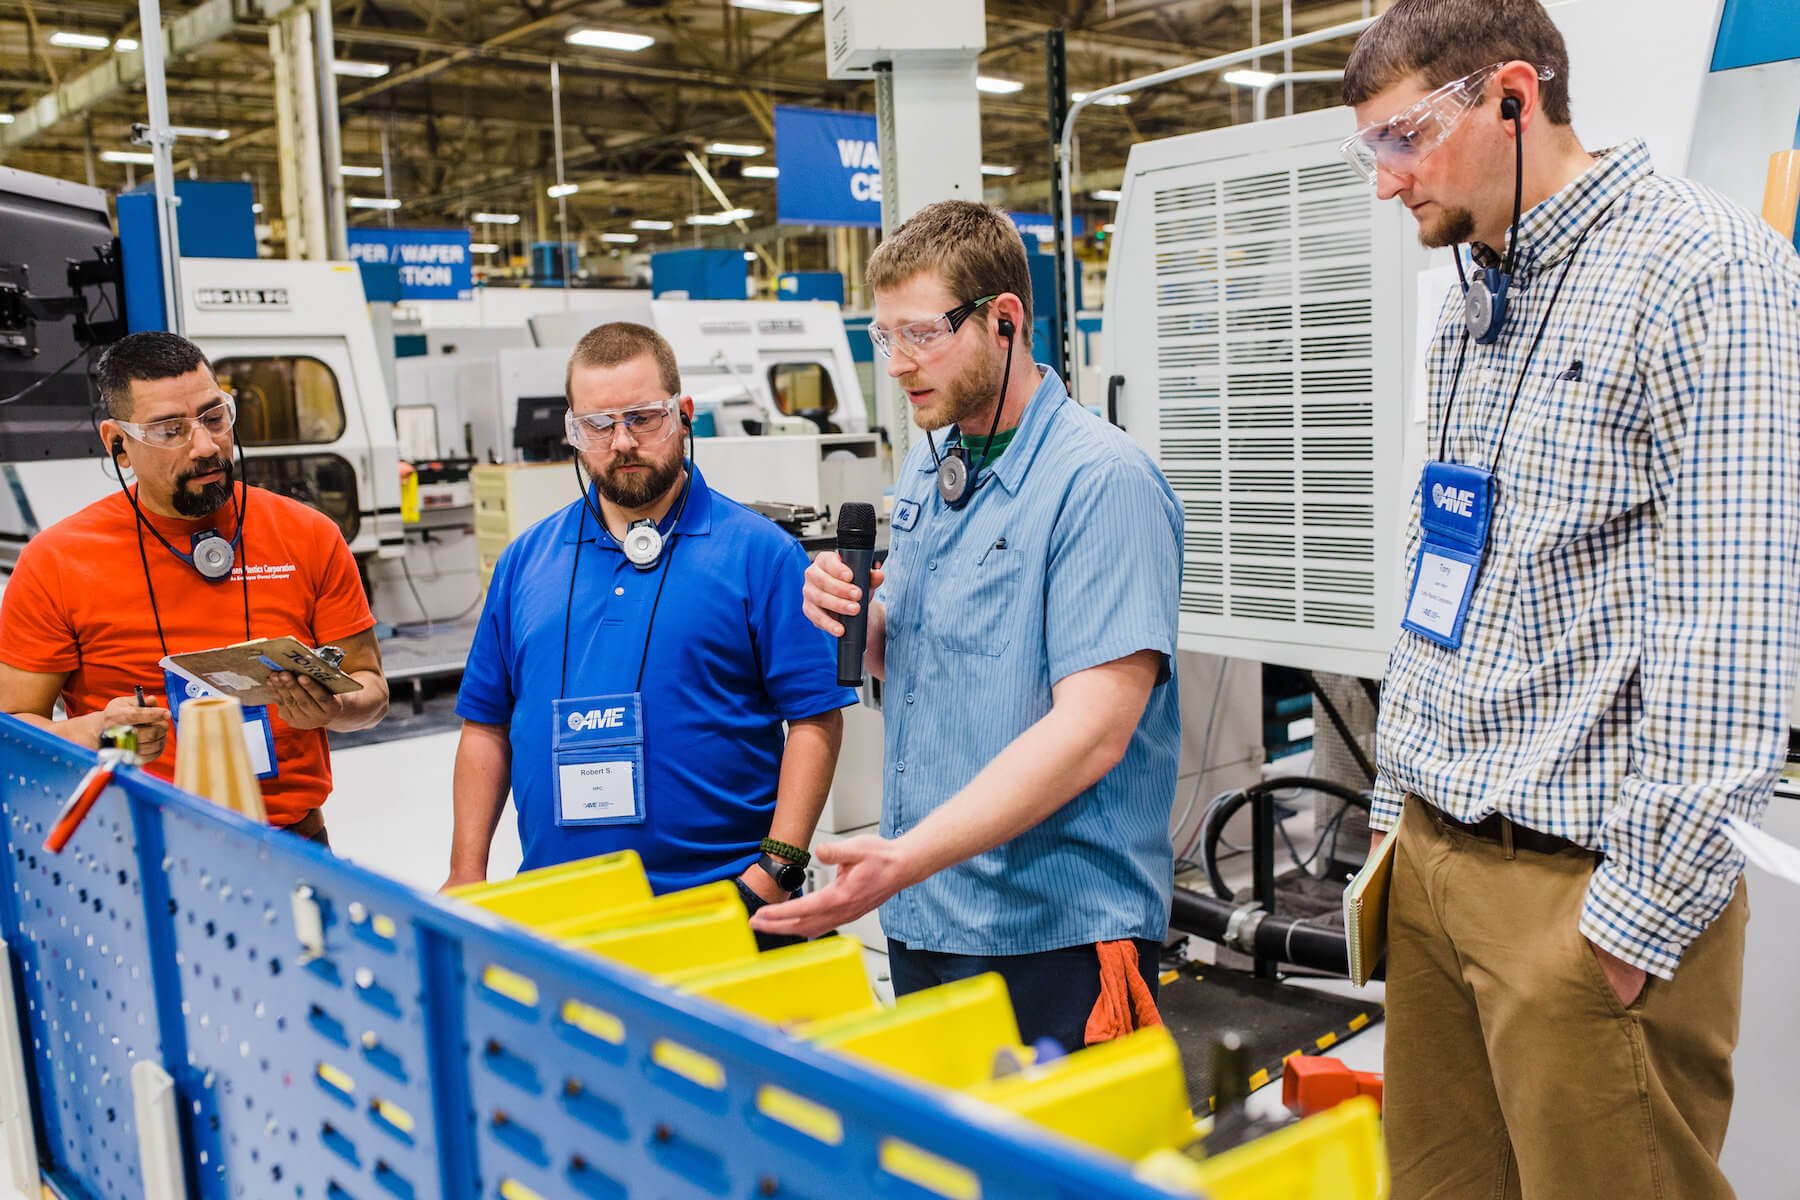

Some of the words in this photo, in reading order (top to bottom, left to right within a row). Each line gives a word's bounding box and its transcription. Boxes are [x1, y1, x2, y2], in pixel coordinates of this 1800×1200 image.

[837, 139, 880, 169] WA
[850, 172, 882, 201] CE
[349, 243, 388, 262] PER
[401, 244, 464, 264] WAFER
[399, 265, 452, 286] TION
[264, 563, 296, 574] Corporation
[282, 650, 337, 681] JORGE
[581, 768, 604, 776] Robert
